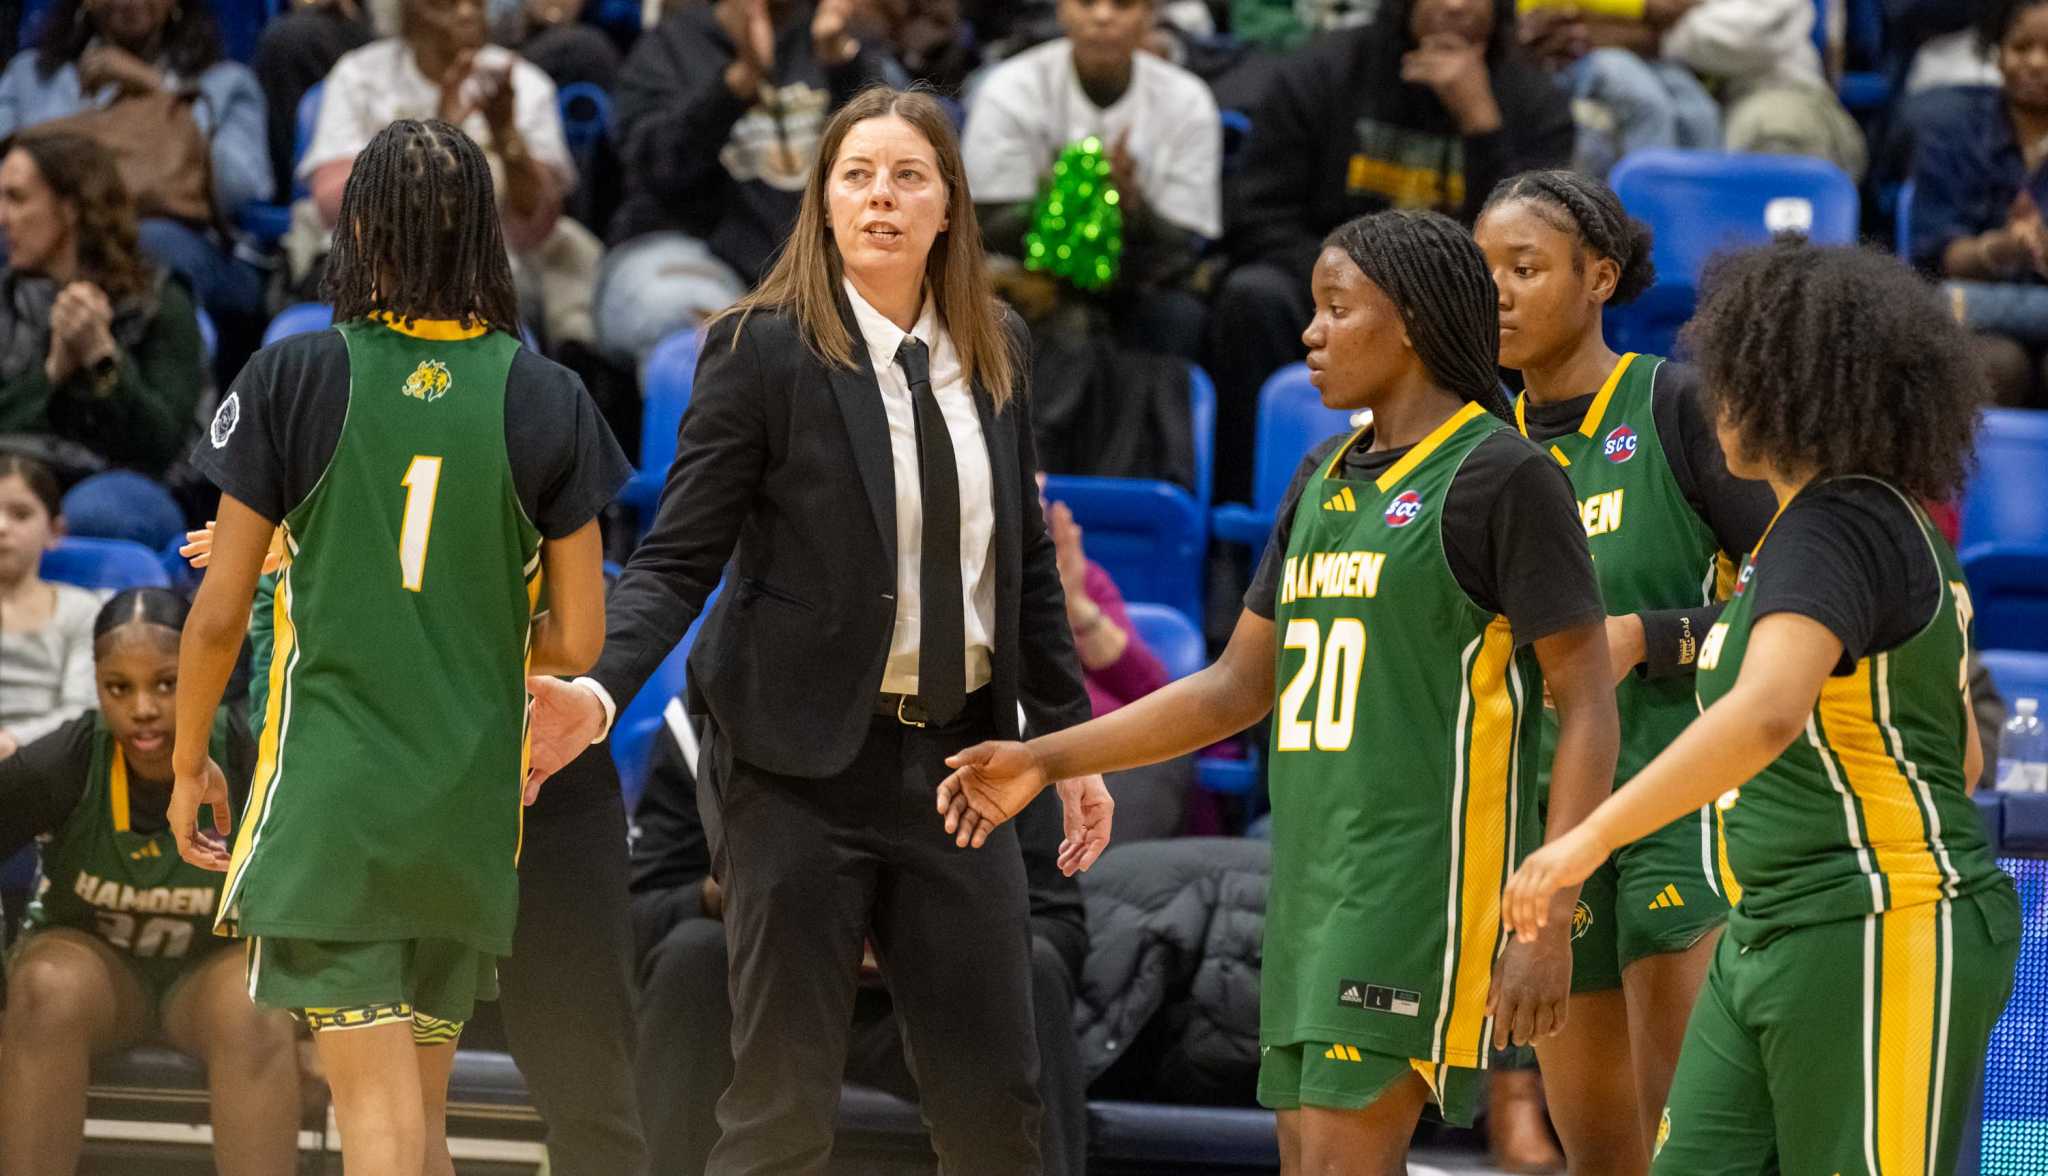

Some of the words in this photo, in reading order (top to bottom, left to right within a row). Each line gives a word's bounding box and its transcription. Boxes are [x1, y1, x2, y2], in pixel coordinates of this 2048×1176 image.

[1604, 434, 1638, 455] SCC
[399, 455, 443, 592] 1
[1385, 500, 1422, 517] SCC
[1281, 552, 1387, 604] HAMDEN
[1278, 617, 1367, 751] 20
[74, 869, 216, 916] HAMDEN
